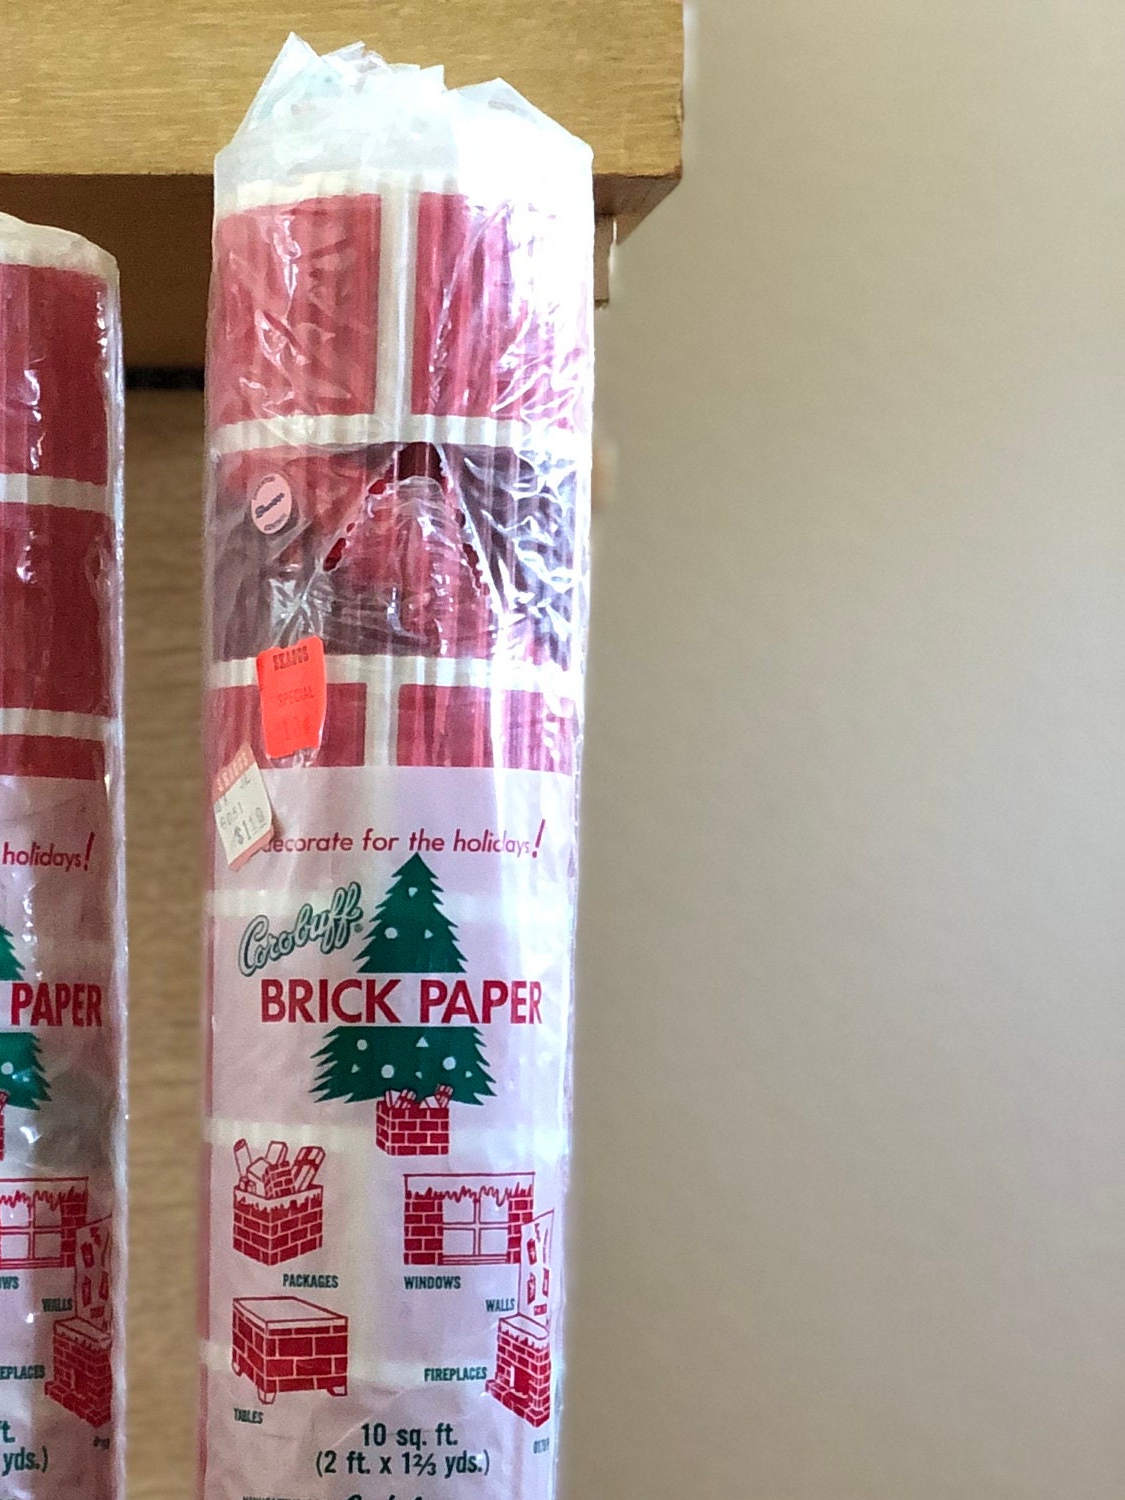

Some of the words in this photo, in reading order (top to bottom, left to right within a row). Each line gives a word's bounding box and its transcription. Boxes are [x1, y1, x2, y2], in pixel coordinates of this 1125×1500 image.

[362, 828, 399, 852] for
[409, 828, 444, 852] the
[3, 832, 95, 873] holidays!
[10, 982, 103, 1028] PAPER
[261, 978, 401, 1024] BRICK
[420, 979, 542, 1024] PAPER
[283, 1274, 339, 1288] PACKAGES
[404, 1275, 461, 1290] WINDOWS
[42, 1298, 73, 1312] WALLS
[485, 1298, 516, 1312] WALLS
[424, 1366, 488, 1381] FIREPLACES
[234, 1407, 263, 1424] TABLES
[361, 1422, 386, 1446] 10
[396, 1428, 427, 1450] sq.
[435, 1421, 459, 1445] ft.
[1, 1446, 49, 1476] yds.)
[315, 1450, 337, 1478] (2
[346, 1450, 371, 1475] ft.
[379, 1457, 392, 1474] x
[444, 1449, 490, 1478] yds.)
